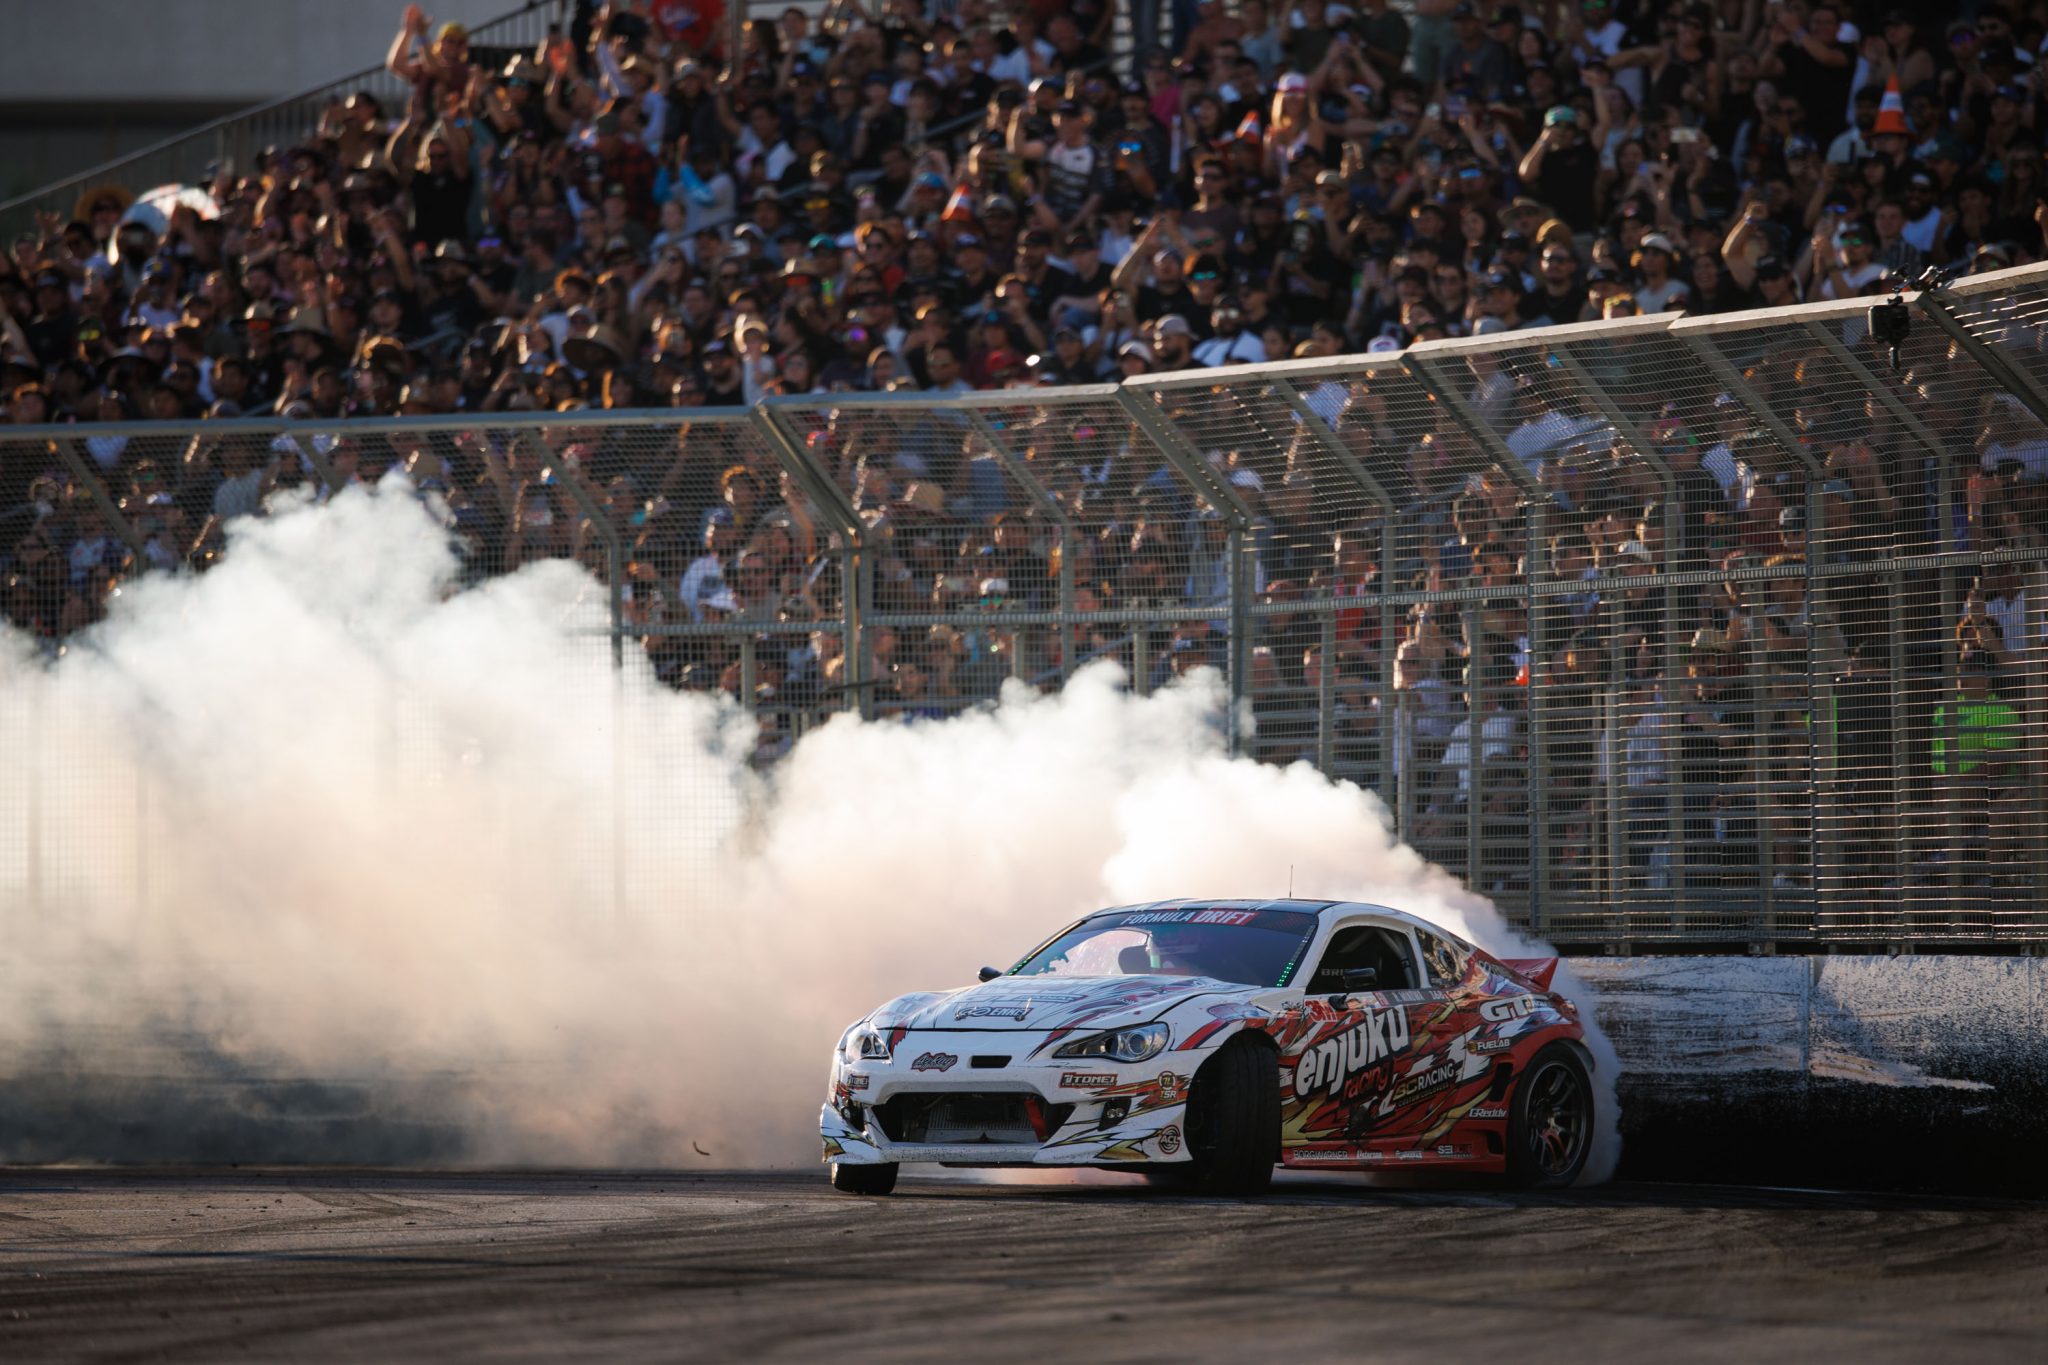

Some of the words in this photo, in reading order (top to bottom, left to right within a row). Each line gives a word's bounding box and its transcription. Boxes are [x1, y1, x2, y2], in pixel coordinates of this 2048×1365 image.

[1120, 911, 1196, 925] FORMULA
[1192, 911, 1255, 924] DRIFT
[1305, 1000, 1338, 1022] 3M
[1477, 1039, 1510, 1050] FUELAB
[1344, 1063, 1389, 1098] racing
[1469, 1108, 1507, 1117] GReddy
[1160, 1134, 1180, 1144] ACL
